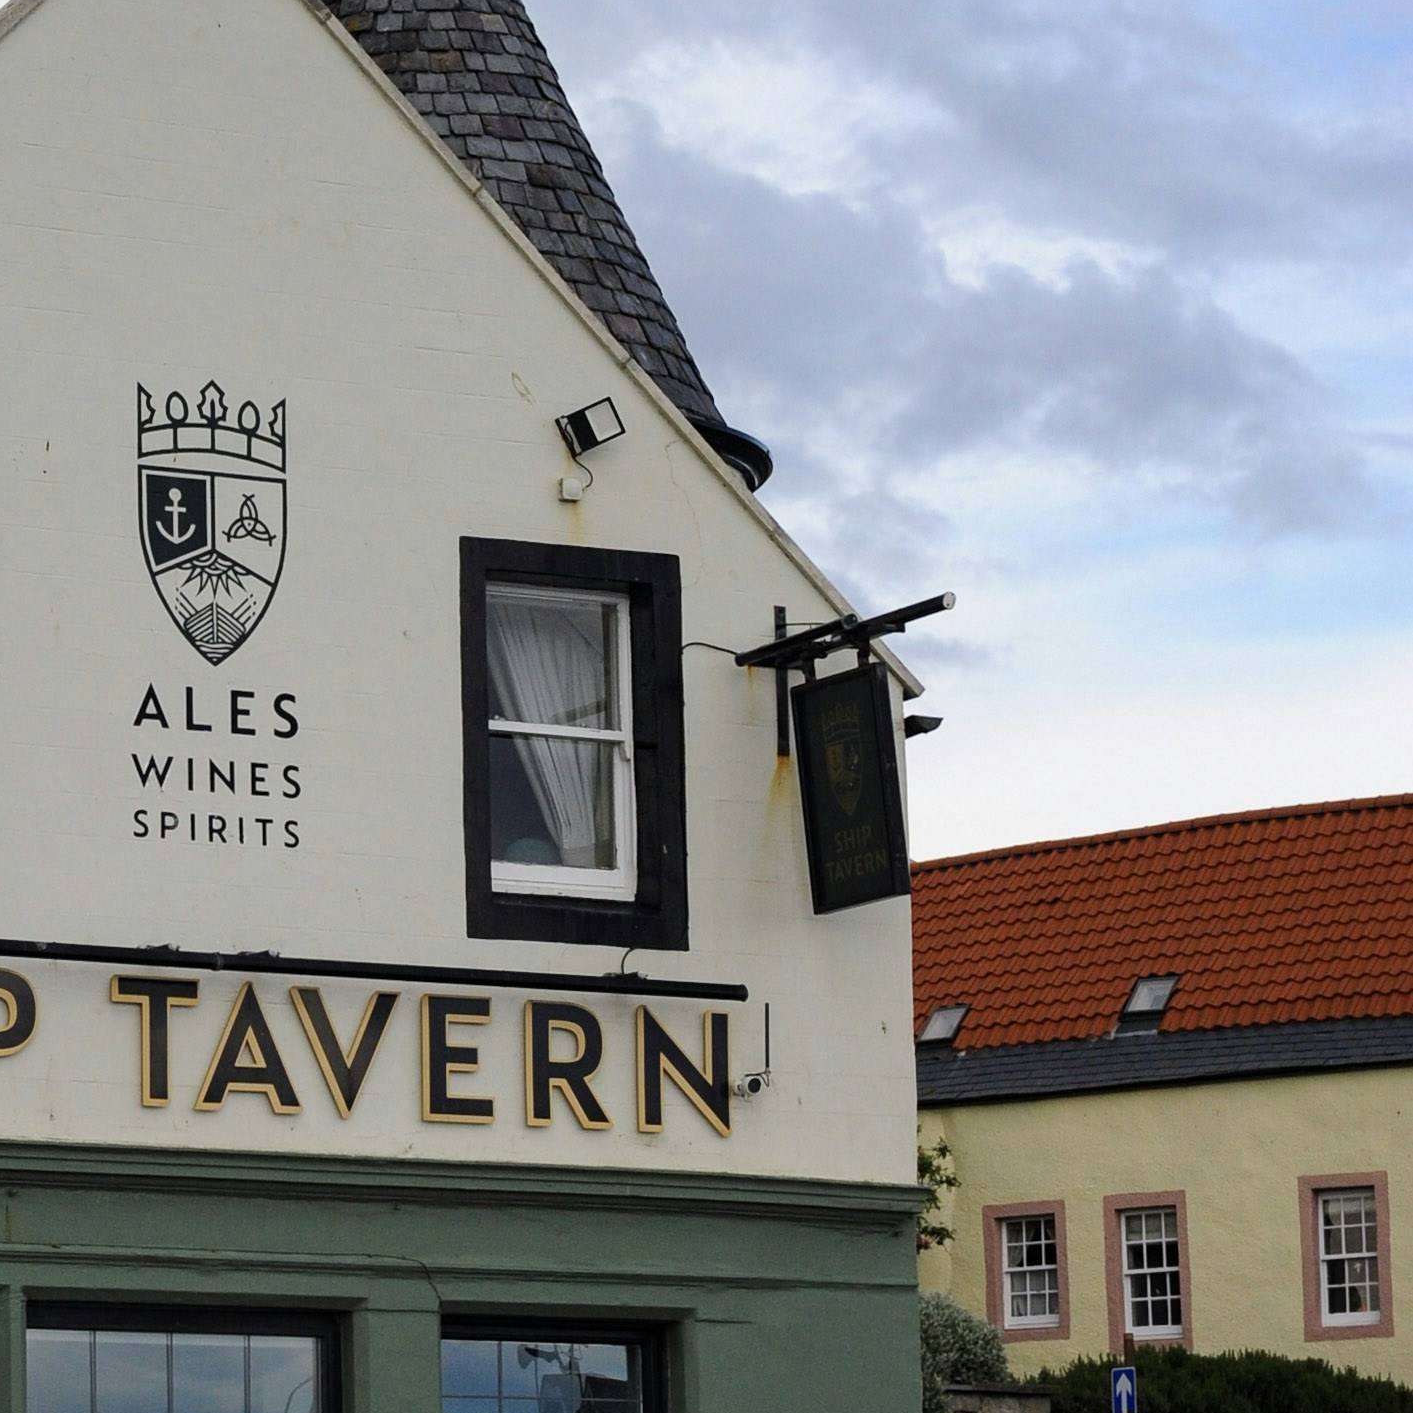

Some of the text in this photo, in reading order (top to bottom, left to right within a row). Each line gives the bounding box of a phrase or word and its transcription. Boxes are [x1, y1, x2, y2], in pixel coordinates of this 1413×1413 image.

[133, 683, 299, 739] ALES
[131, 753, 301, 799] WINES
[133, 809, 301, 848] SPIRITS
[834, 825, 871, 854] SHIP
[824, 849, 887, 883] TAVERN
[110, 974, 732, 1138] TAVERN
